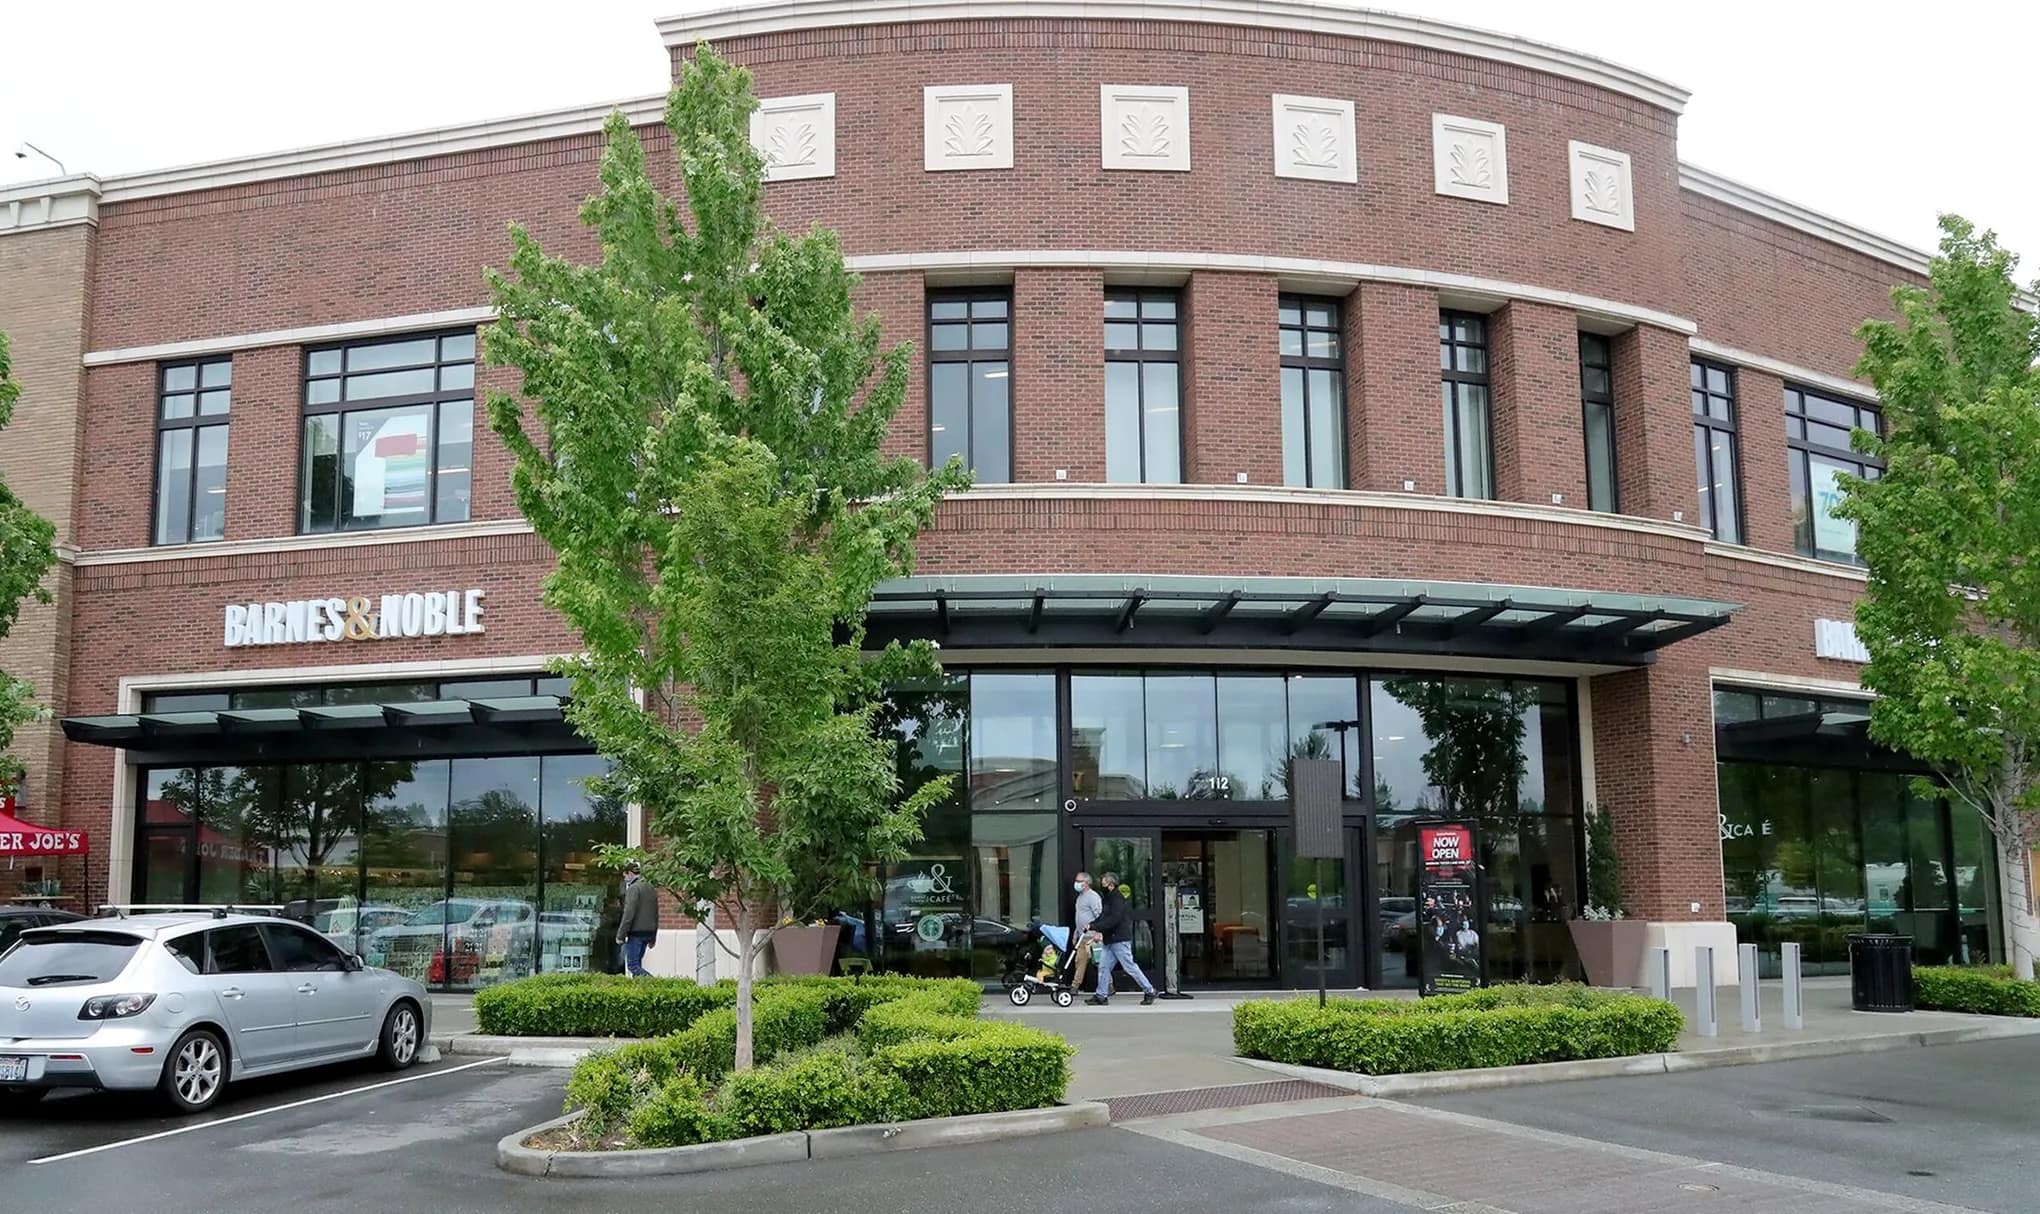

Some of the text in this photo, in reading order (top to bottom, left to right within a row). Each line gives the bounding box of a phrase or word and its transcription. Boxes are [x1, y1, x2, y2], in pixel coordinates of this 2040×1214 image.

[1209, 776, 1229, 790] 112
[28, 832, 81, 850] JOE'S
[1433, 836, 1460, 848] NOW
[1431, 847, 1460, 859] OPEN
